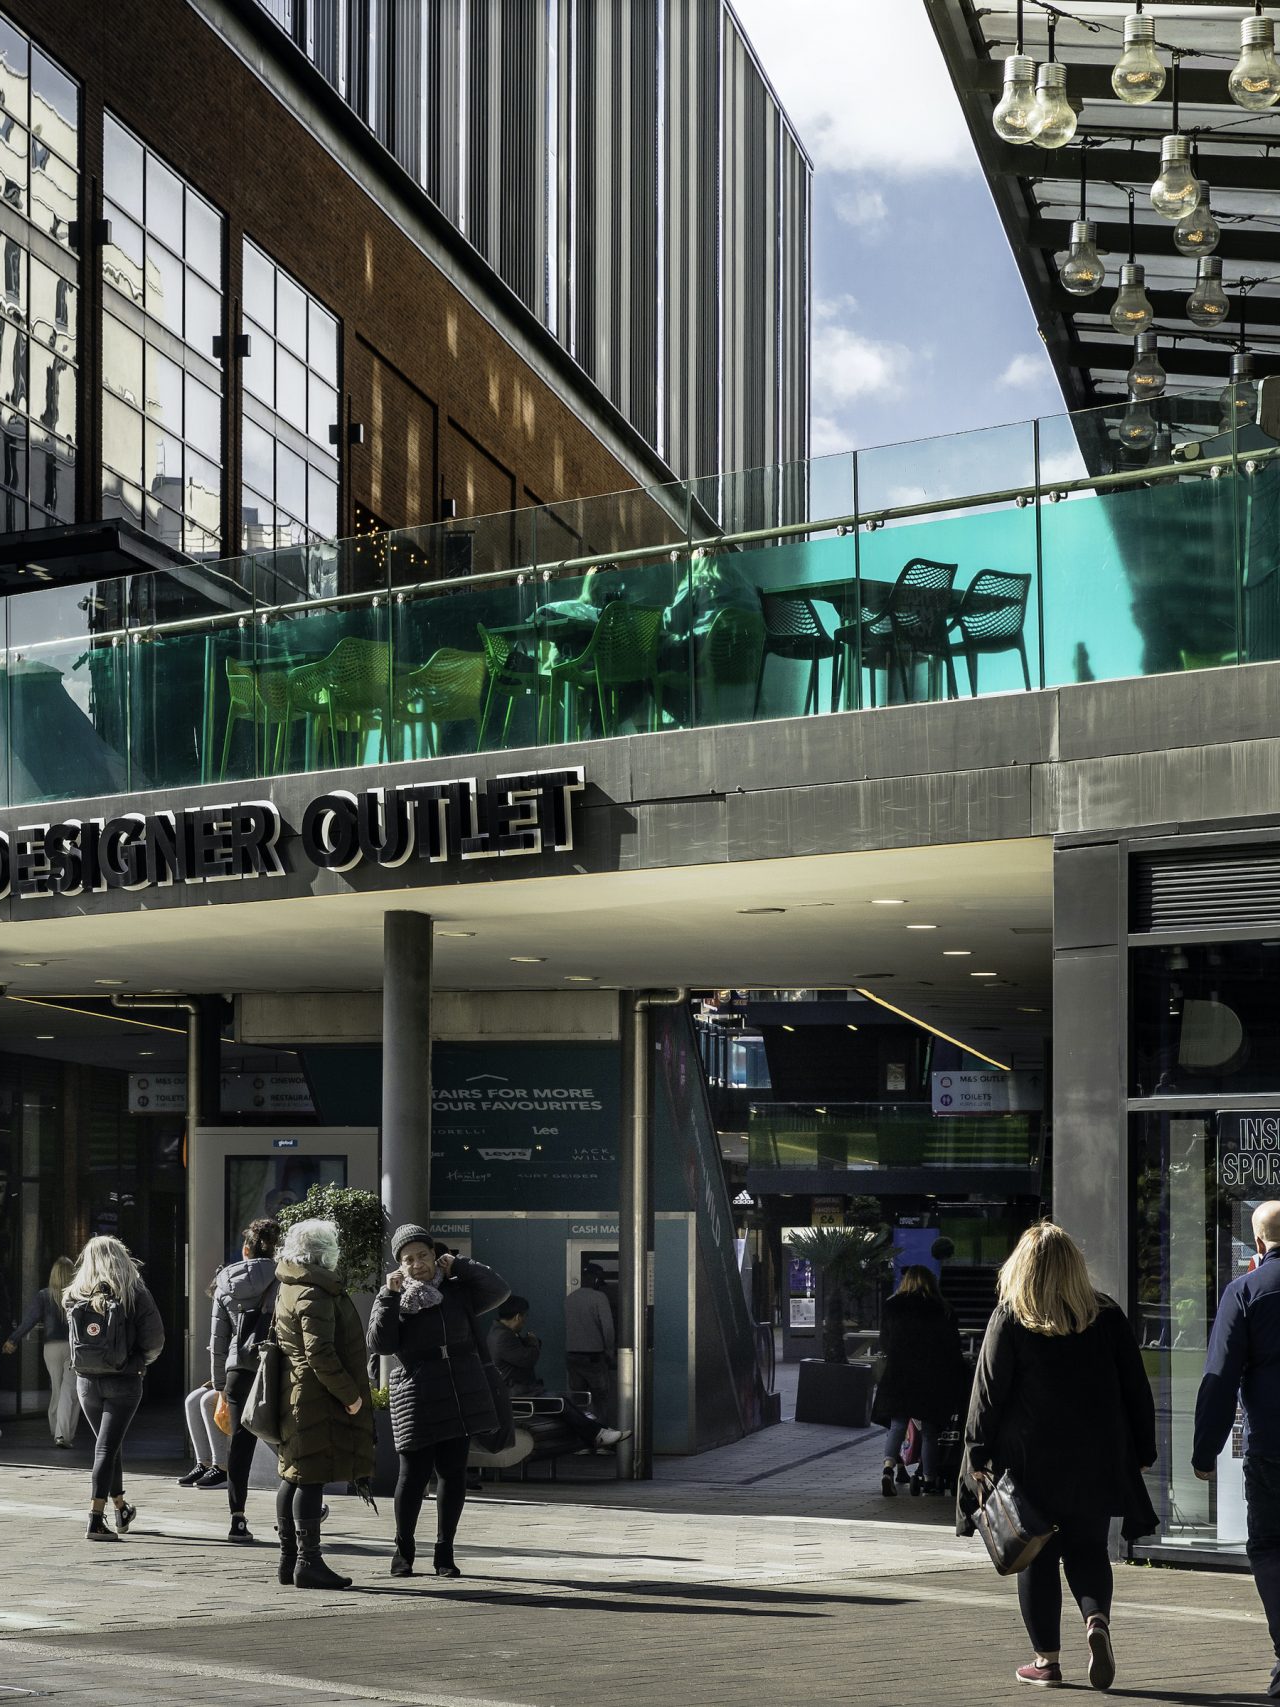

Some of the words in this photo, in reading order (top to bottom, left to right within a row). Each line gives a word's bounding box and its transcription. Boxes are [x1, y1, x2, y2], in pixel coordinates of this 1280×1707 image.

[302, 766, 585, 872] OUTLET
[487, 1088, 529, 1099] FOR
[533, 1087, 595, 1098] MORE
[481, 1100, 603, 1111] FAVOURITES
[531, 1126, 560, 1135] Lee
[1222, 1152, 1280, 1186] SPOR
[571, 1225, 598, 1234] CASH
